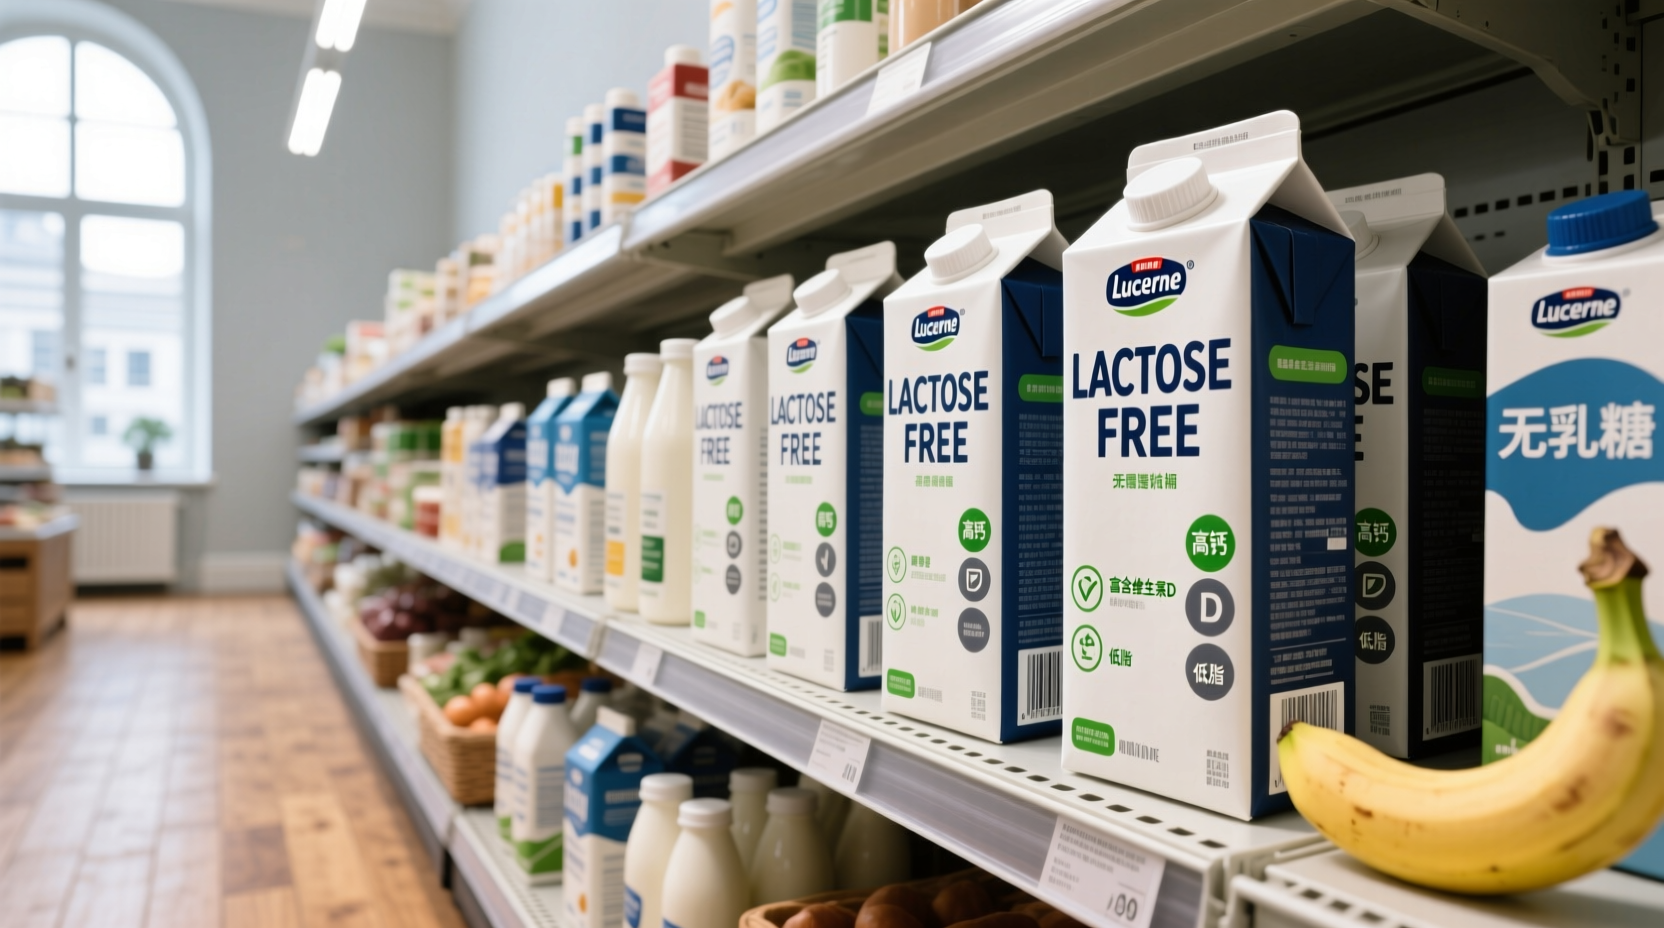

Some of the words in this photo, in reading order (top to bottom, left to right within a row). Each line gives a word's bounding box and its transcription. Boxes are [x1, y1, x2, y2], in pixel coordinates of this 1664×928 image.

[1112, 272, 1181, 299] Lucerne
[1536, 298, 1617, 324] Lucerne
[1072, 338, 1231, 399] LACTOSE
[771, 391, 836, 425] LACTOSE
[888, 370, 989, 415] LACTOSE
[904, 421, 968, 463] FREE
[1097, 404, 1200, 458] FREE
[1498, 400, 1656, 460] 无乳糖
[701, 437, 730, 465] FREE
[781, 432, 821, 465] FREE
[1191, 529, 1228, 556] 高钙
[1357, 520, 1389, 543] 高钙
[1200, 592, 1223, 623] D
[1192, 663, 1225, 686] 低脂
